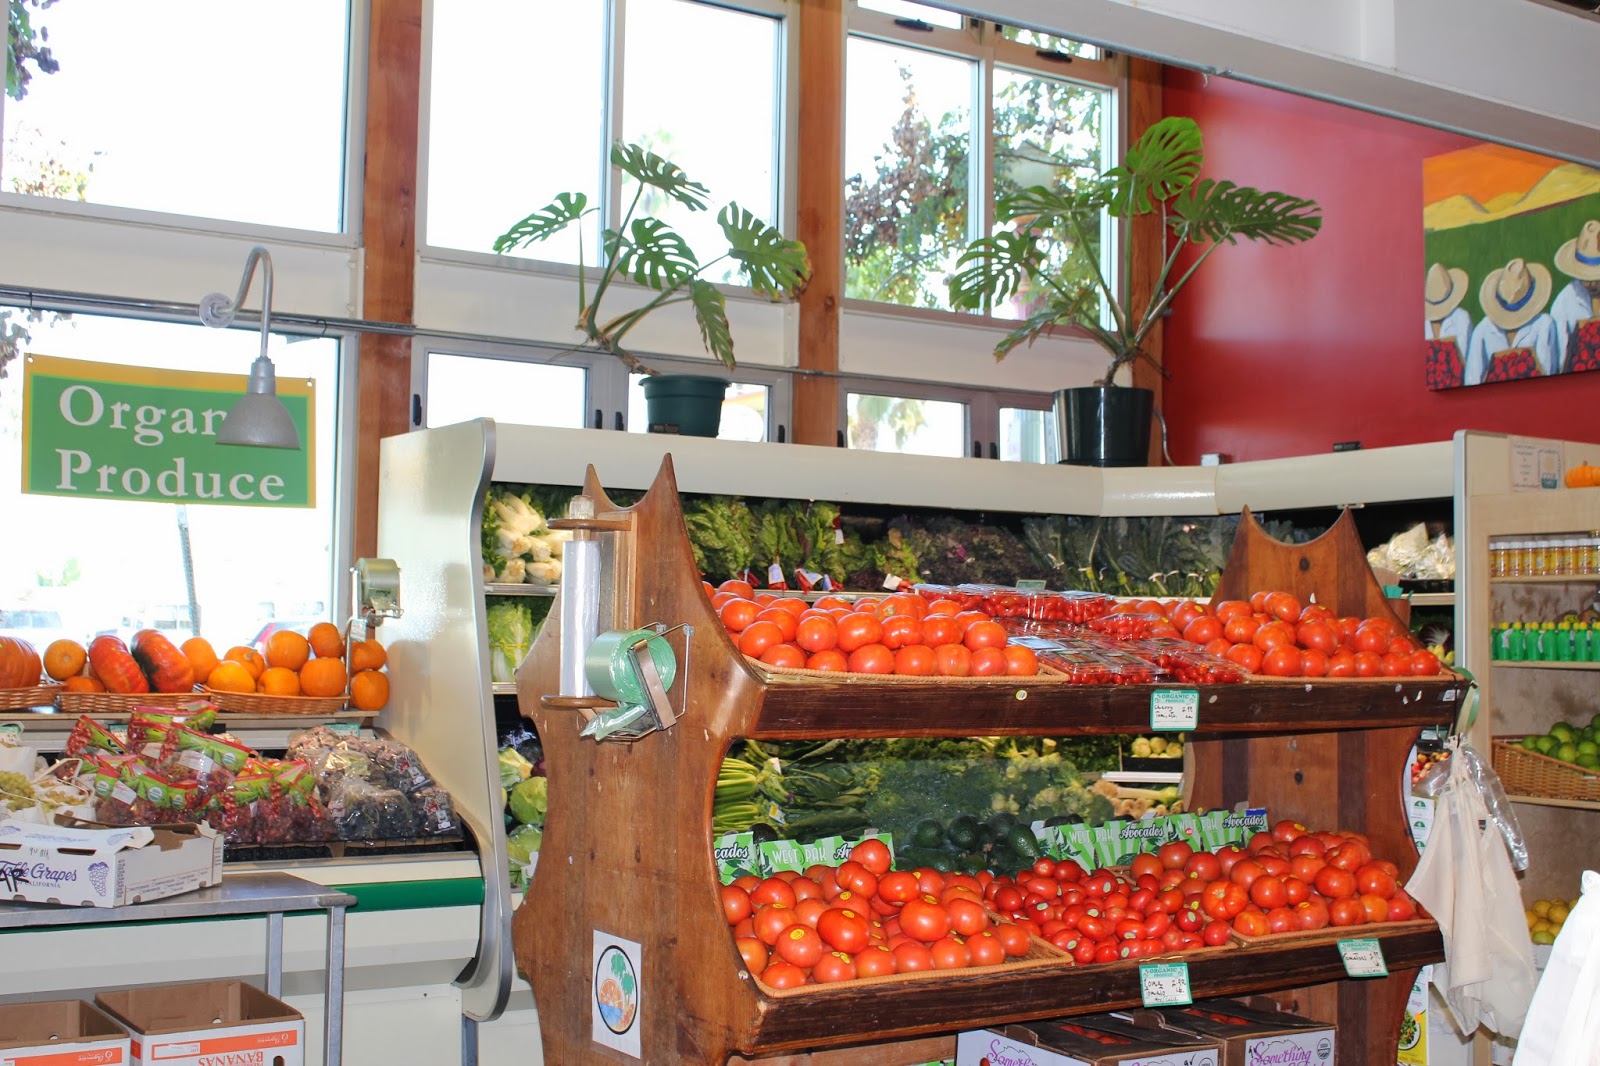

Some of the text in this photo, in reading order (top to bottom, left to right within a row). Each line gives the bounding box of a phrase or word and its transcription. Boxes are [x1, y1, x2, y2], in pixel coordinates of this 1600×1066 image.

[59, 385, 227, 446] Organ
[55, 448, 285, 501] Produce
[1201, 818, 1218, 831] PAK
[1222, 814, 1264, 828] Avocados
[1068, 823, 1164, 844] WEST PAK Avocados
[714, 842, 749, 860] cados
[771, 848, 799, 865] WEST
[805, 847, 827, 863] PAK
[31, 863, 77, 883] Grapes
[198, 1051, 264, 1066] BANANAS
[1250, 1041, 1312, 1066] Something
